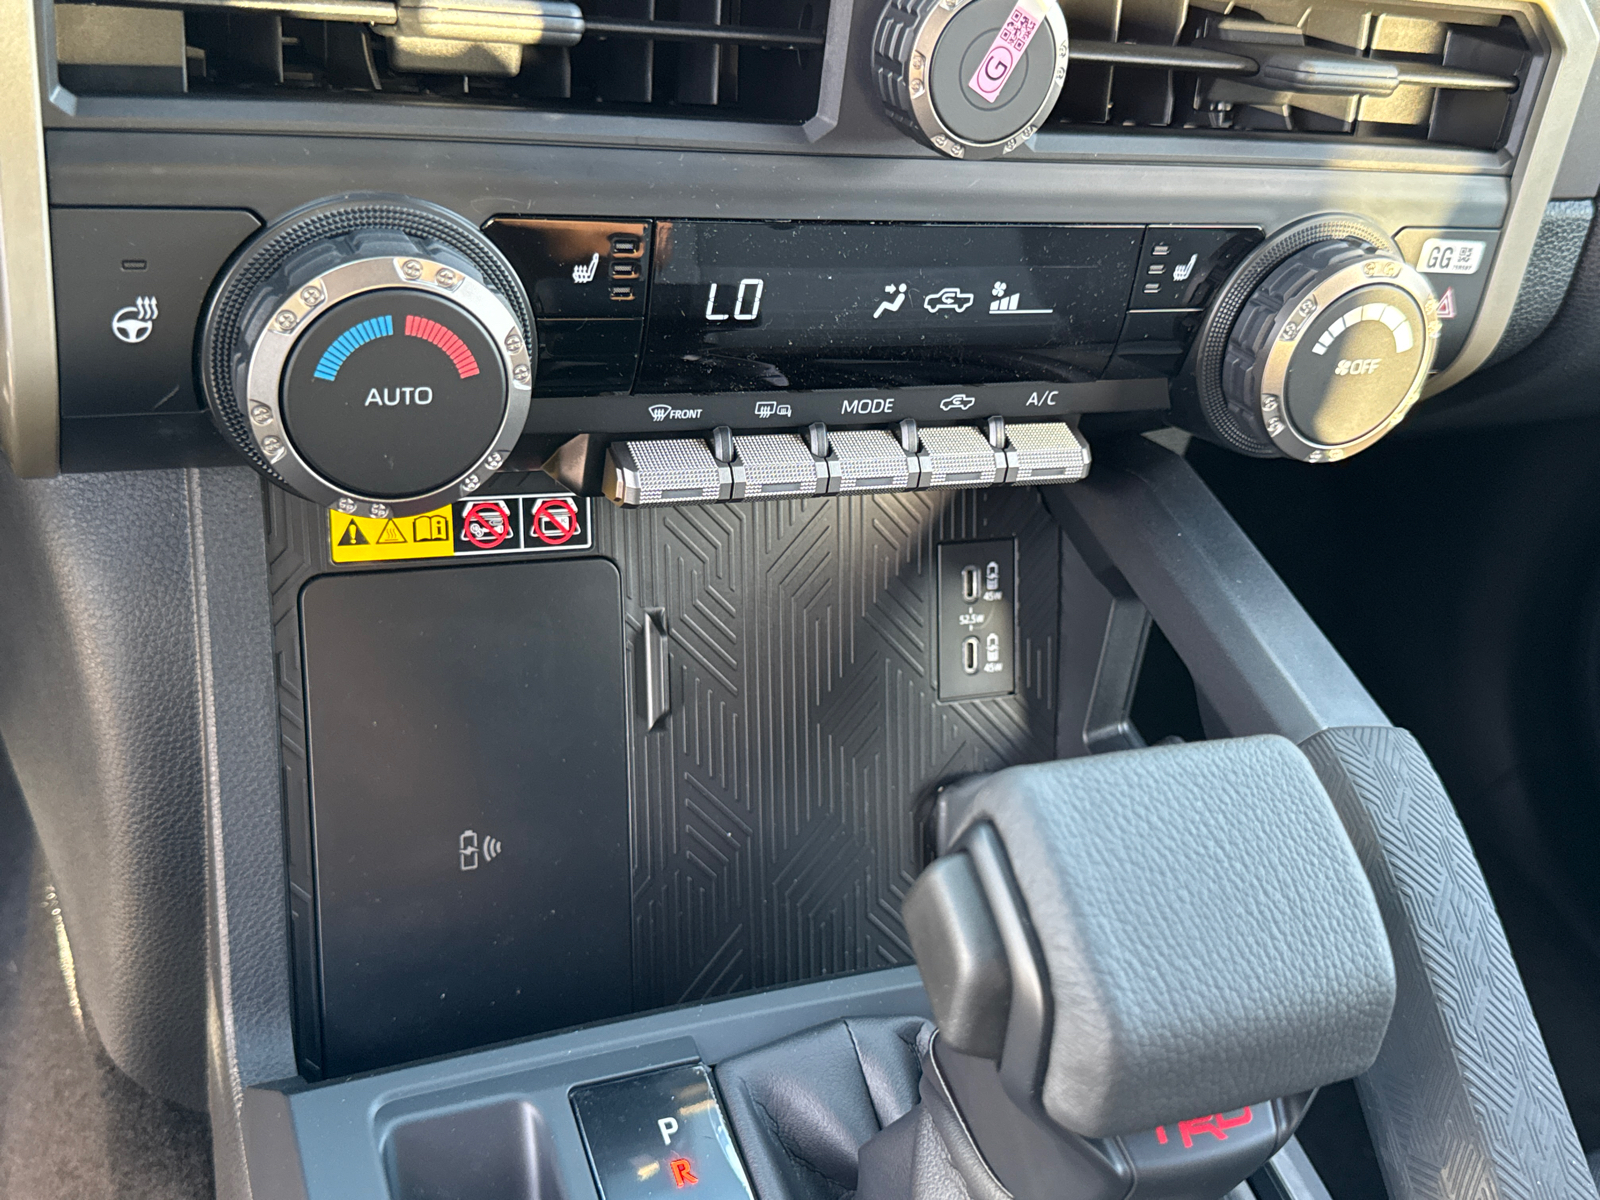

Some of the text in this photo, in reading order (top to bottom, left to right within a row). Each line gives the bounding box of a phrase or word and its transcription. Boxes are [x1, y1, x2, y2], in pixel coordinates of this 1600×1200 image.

[984, 55, 1008, 81] G
[1426, 246, 1454, 269] GG
[1349, 358, 1382, 375] OFF
[364, 386, 433, 407] AUTO
[841, 398, 895, 415] MODE
[1025, 390, 1059, 406] A/C
[669, 408, 703, 420] FRONT
[657, 1116, 679, 1146] P
[670, 1158, 699, 1189] R
